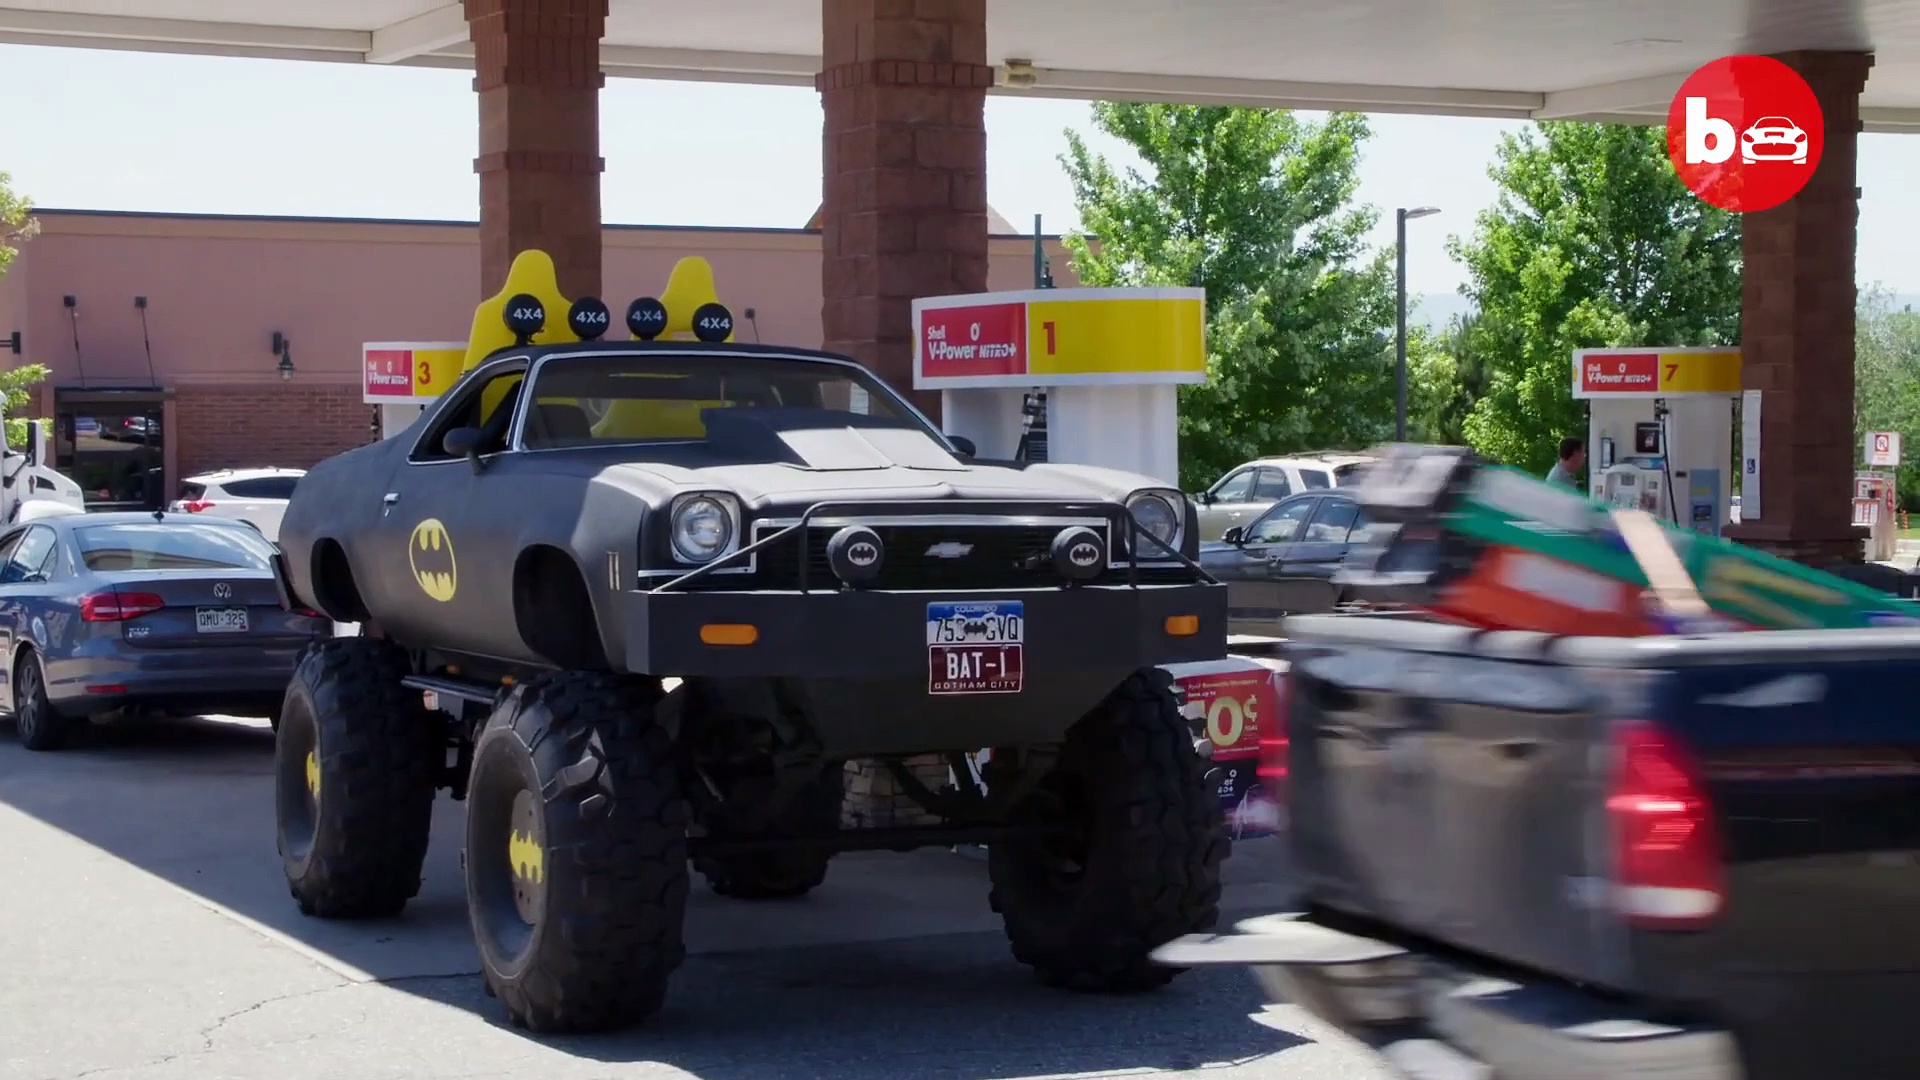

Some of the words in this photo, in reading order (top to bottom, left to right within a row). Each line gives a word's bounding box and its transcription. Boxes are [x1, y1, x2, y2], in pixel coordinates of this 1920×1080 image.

[927, 325, 946, 340] Shell
[1042, 321, 1056, 356] 1
[928, 341, 976, 360] V-Power
[978, 343, 1017, 359] NITRO+
[418, 361, 431, 386] 3
[1587, 371, 1623, 384] V-Power
[1665, 363, 1680, 382] 7
[934, 681, 987, 691] GOTHAM
[990, 680, 1018, 690] CITY
